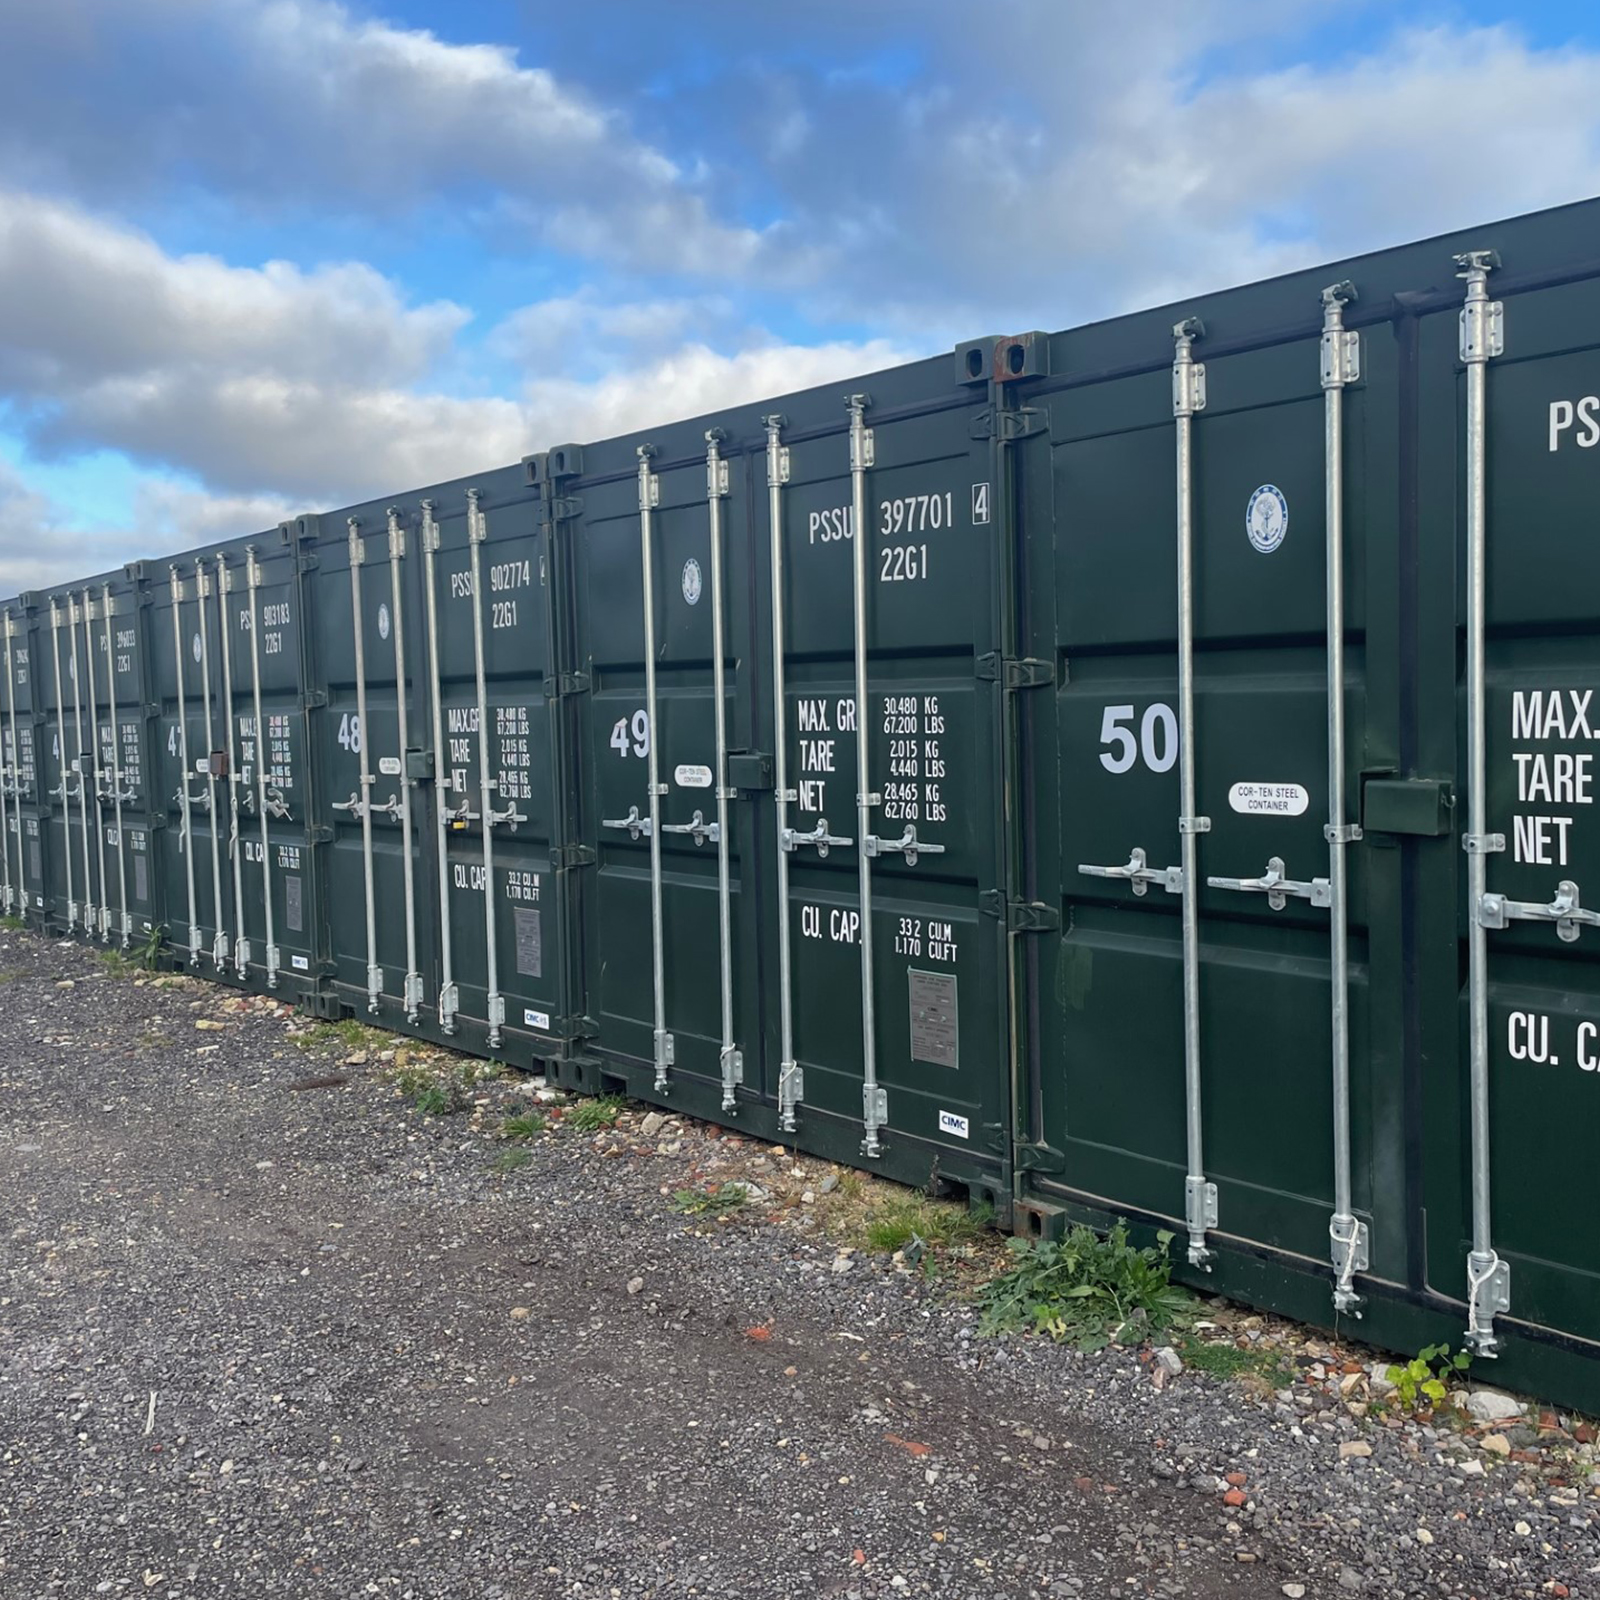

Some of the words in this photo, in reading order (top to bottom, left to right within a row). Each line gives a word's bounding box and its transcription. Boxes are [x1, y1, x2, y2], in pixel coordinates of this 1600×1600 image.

[809, 505, 853, 544] PSSU
[880, 491, 952, 535] 397701
[974, 485, 988, 522] 4
[490, 560, 530, 591] 902774
[880, 544, 927, 581] 22G1
[492, 600, 517, 628] 22G1
[798, 699, 831, 732] MAX.
[924, 696, 939, 715] KG
[1512, 690, 1600, 739] MAX.
[338, 713, 361, 754] 48
[610, 709, 650, 758] 49
[924, 716, 945, 734] LBS
[1099, 703, 1178, 774] 50
[449, 739, 471, 763] TARE
[799, 740, 836, 772] TARE
[925, 740, 939, 758] KG
[451, 769, 467, 792] NET
[925, 759, 946, 778] LBS
[1512, 753, 1593, 804] TARE
[799, 780, 825, 812] NET
[925, 783, 940, 802] KG
[1238, 786, 1273, 798] COR-TEN
[1275, 788, 1299, 799] STEEL
[1248, 800, 1289, 811] CONTAINER
[926, 803, 947, 822] LBS
[1513, 815, 1573, 866] NET
[801, 906, 822, 939] CU.
[829, 909, 862, 944] CAP.
[928, 941, 958, 962] CU.FT
[1507, 1011, 1559, 1066] CU.
[941, 1115, 966, 1131] CIMC
